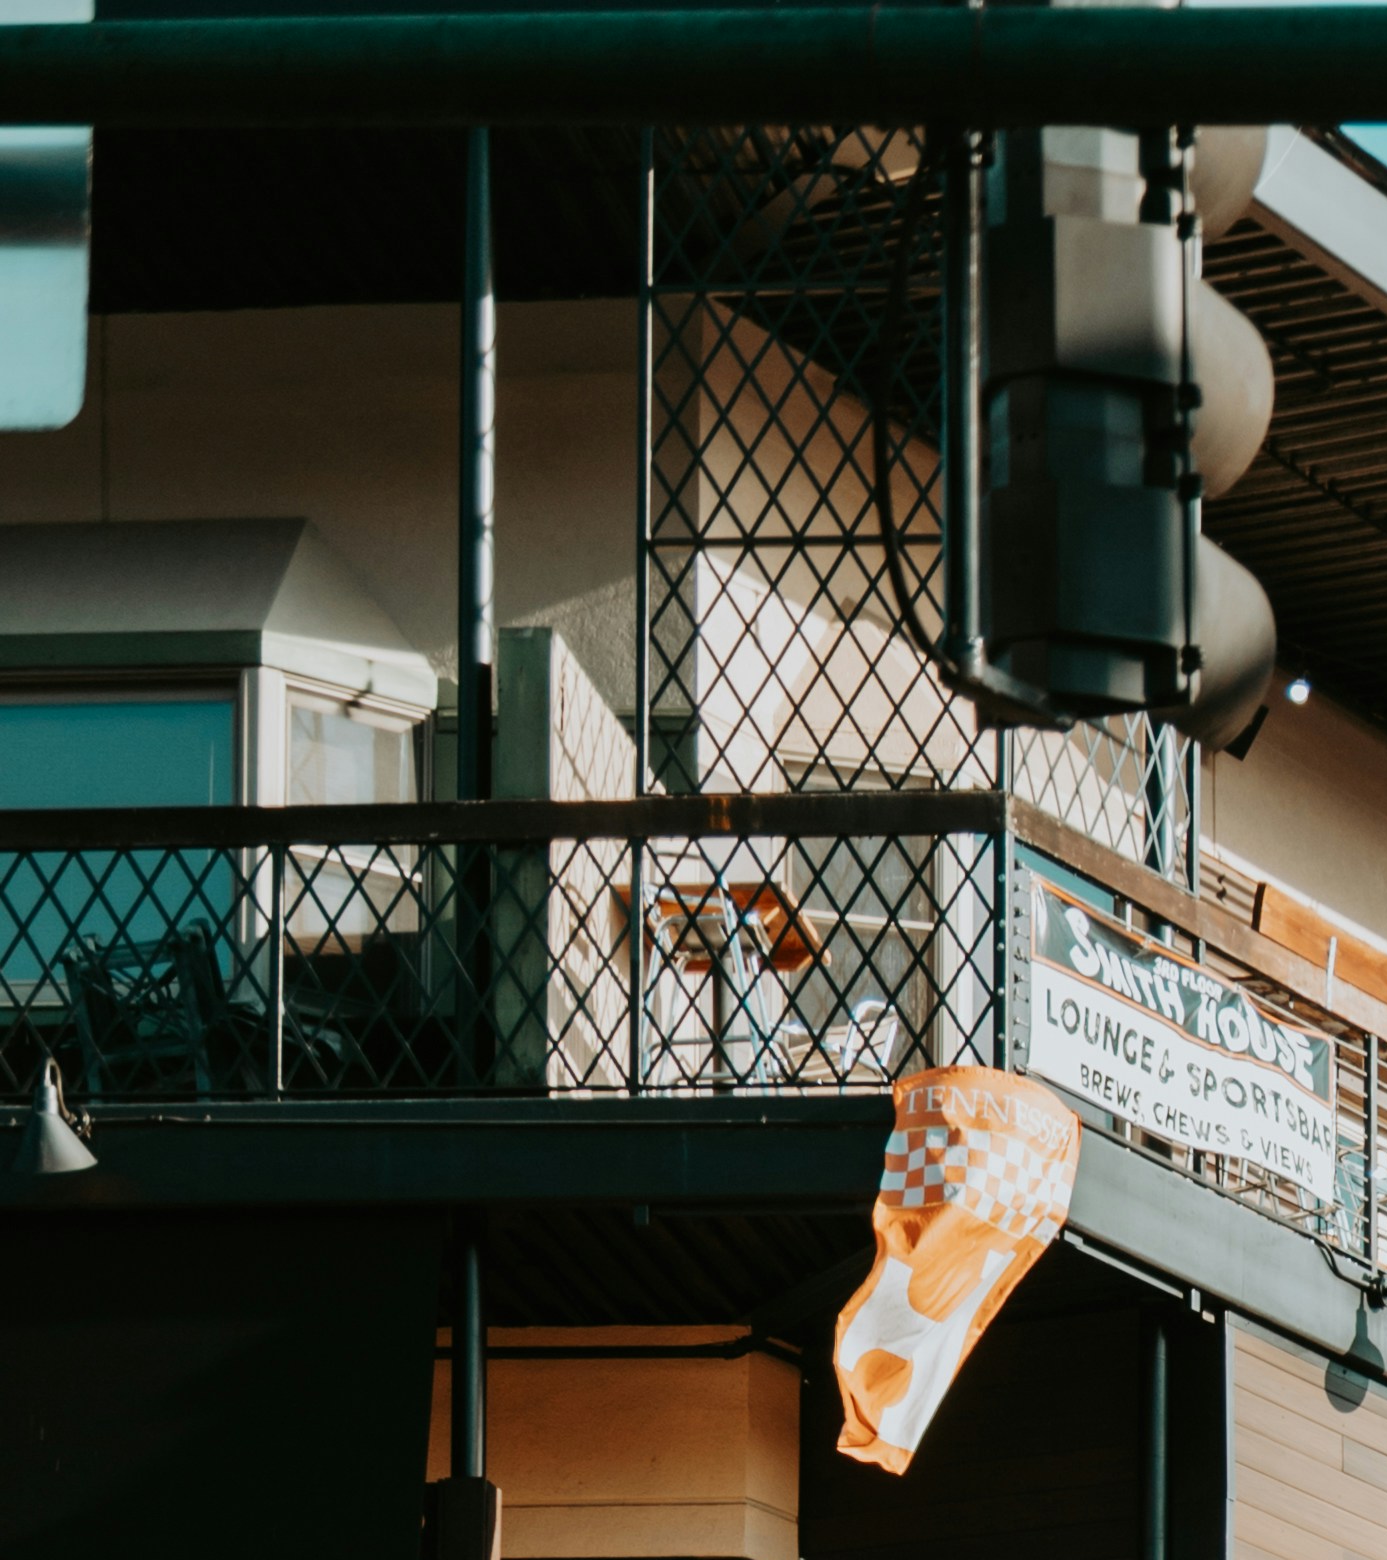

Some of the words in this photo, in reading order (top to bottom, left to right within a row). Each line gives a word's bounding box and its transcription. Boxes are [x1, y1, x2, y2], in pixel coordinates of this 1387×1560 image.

[1064, 907, 1186, 1026] SMITH
[1197, 994, 1315, 1092] HOUSE
[1153, 957, 1179, 982] 3RD
[1181, 970, 1223, 998] FLOOR
[1046, 989, 1155, 1074] LOUNGE
[1159, 1048, 1175, 1084] &
[1186, 1062, 1333, 1156] SPORTSBAR
[1080, 1063, 1145, 1122] BREWS,
[1153, 1101, 1230, 1146] CHEWS
[1240, 1128, 1254, 1150] &
[1261, 1136, 1313, 1184] VIEWS
